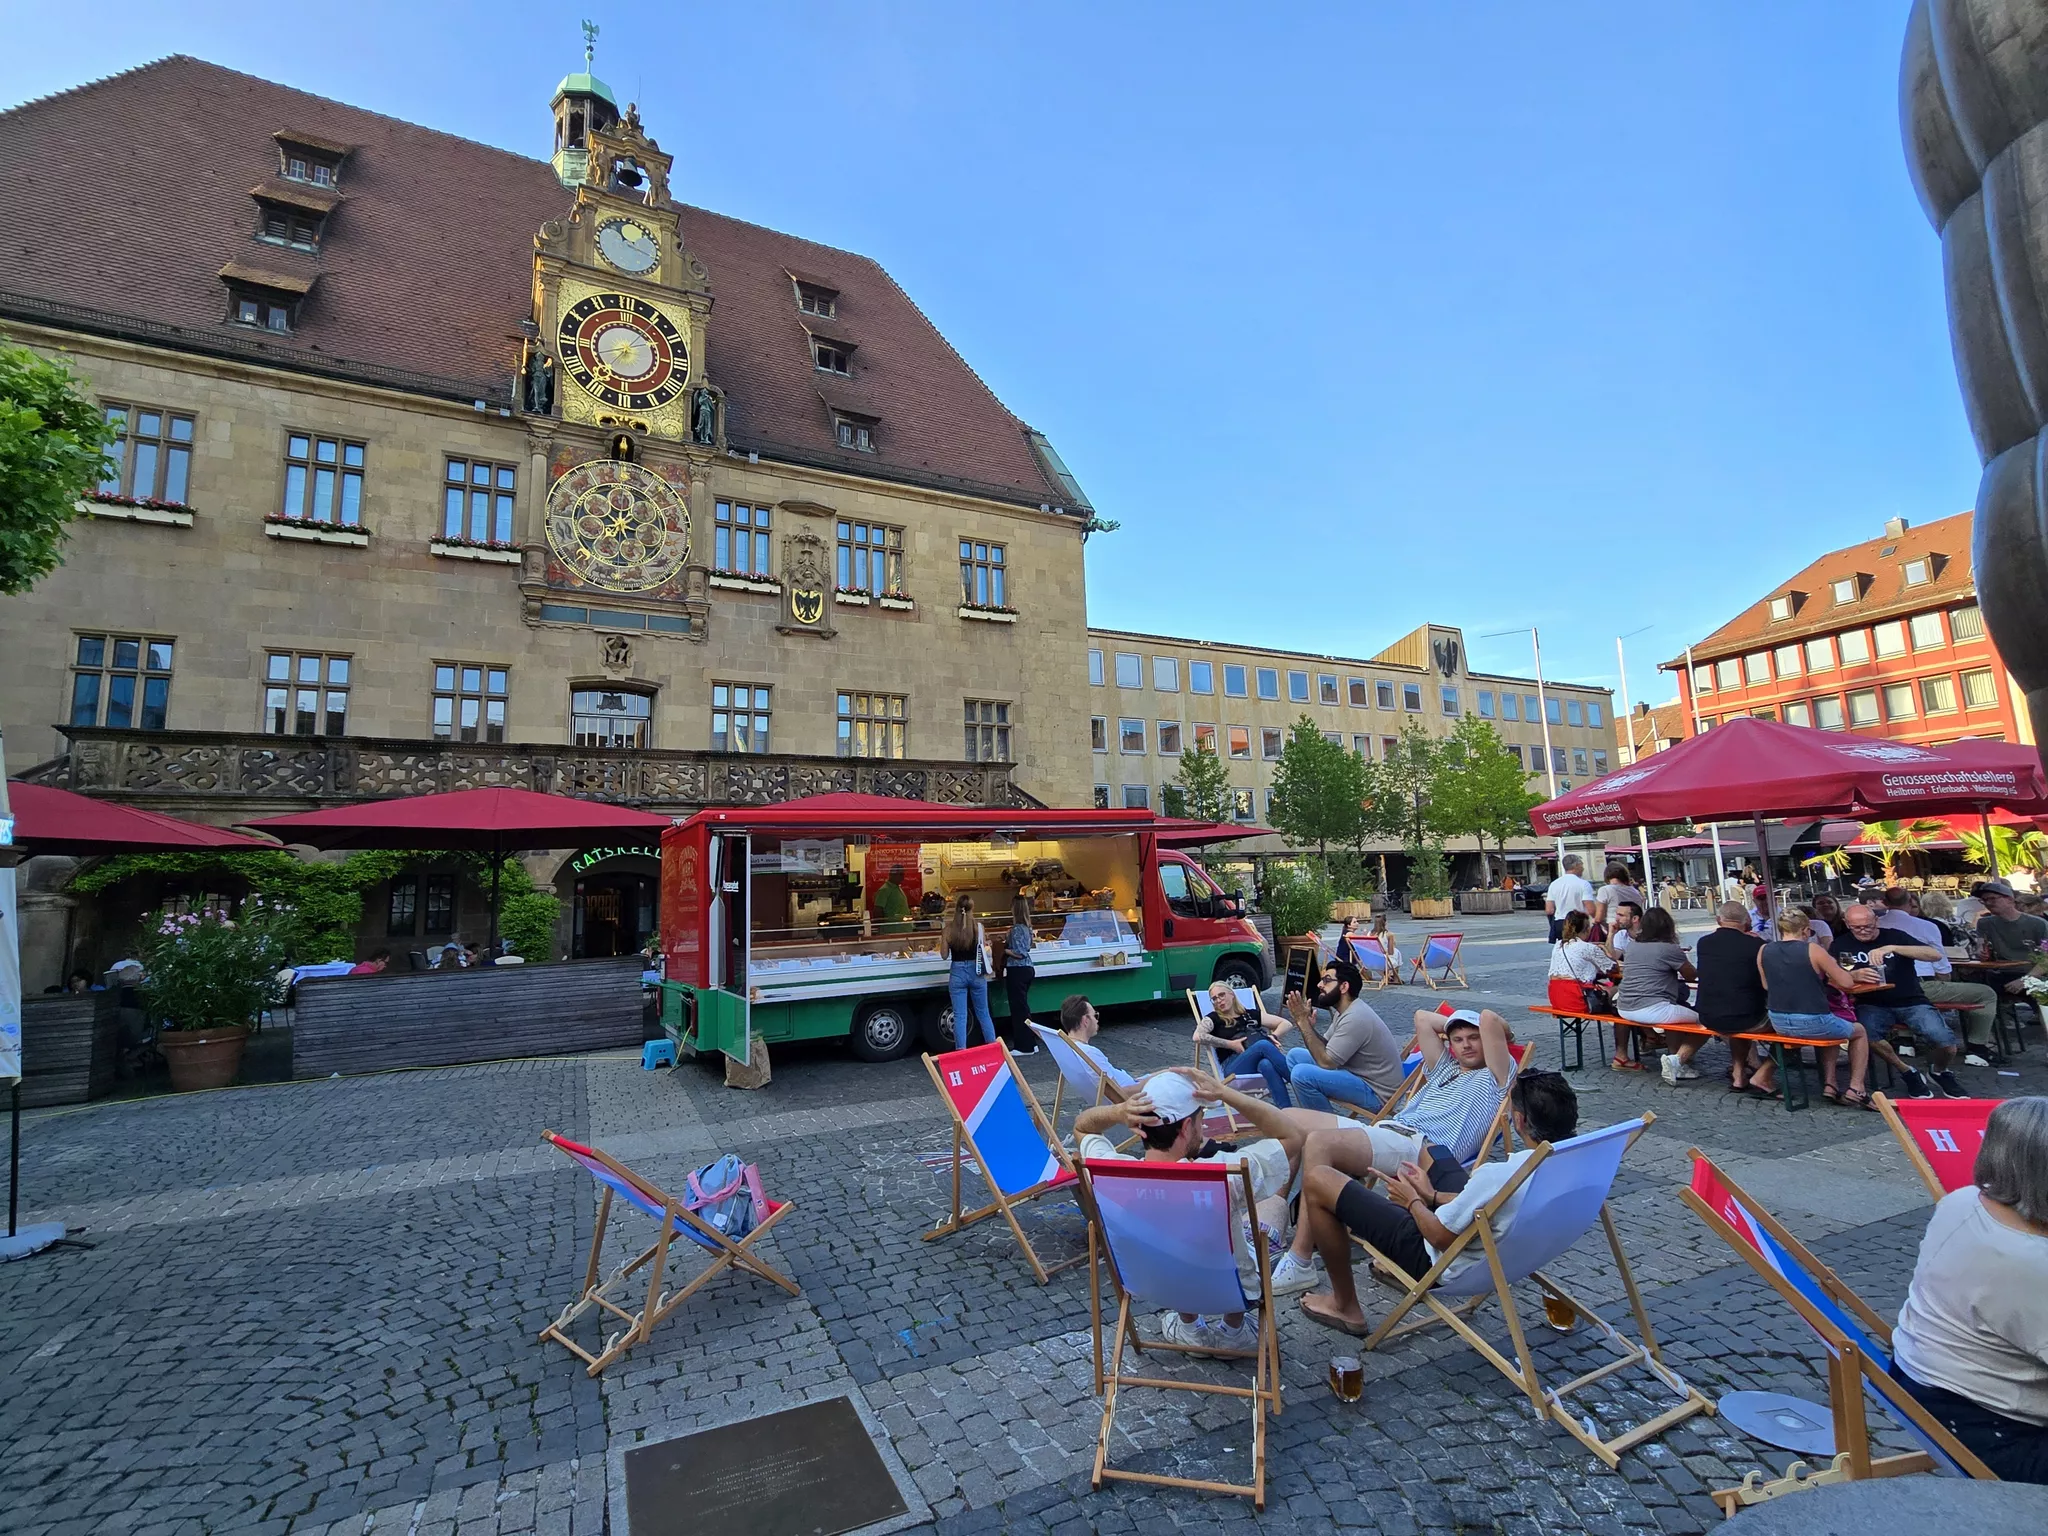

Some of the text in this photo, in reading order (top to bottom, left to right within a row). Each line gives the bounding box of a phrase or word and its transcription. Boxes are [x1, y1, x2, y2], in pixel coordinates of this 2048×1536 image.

[1882, 770, 2016, 787] Genossenschaftskellerei
[1886, 786, 1926, 797] Heilbronn
[1931, 785, 1969, 794] Erlenbach
[1972, 784, 2008, 795] Weinsberg
[1542, 800, 1621, 823] Genossenschaftskellerei
[1593, 814, 1618, 823] Weinsberg
[948, 1070, 964, 1087] H
[1925, 1129, 1960, 1152] H
